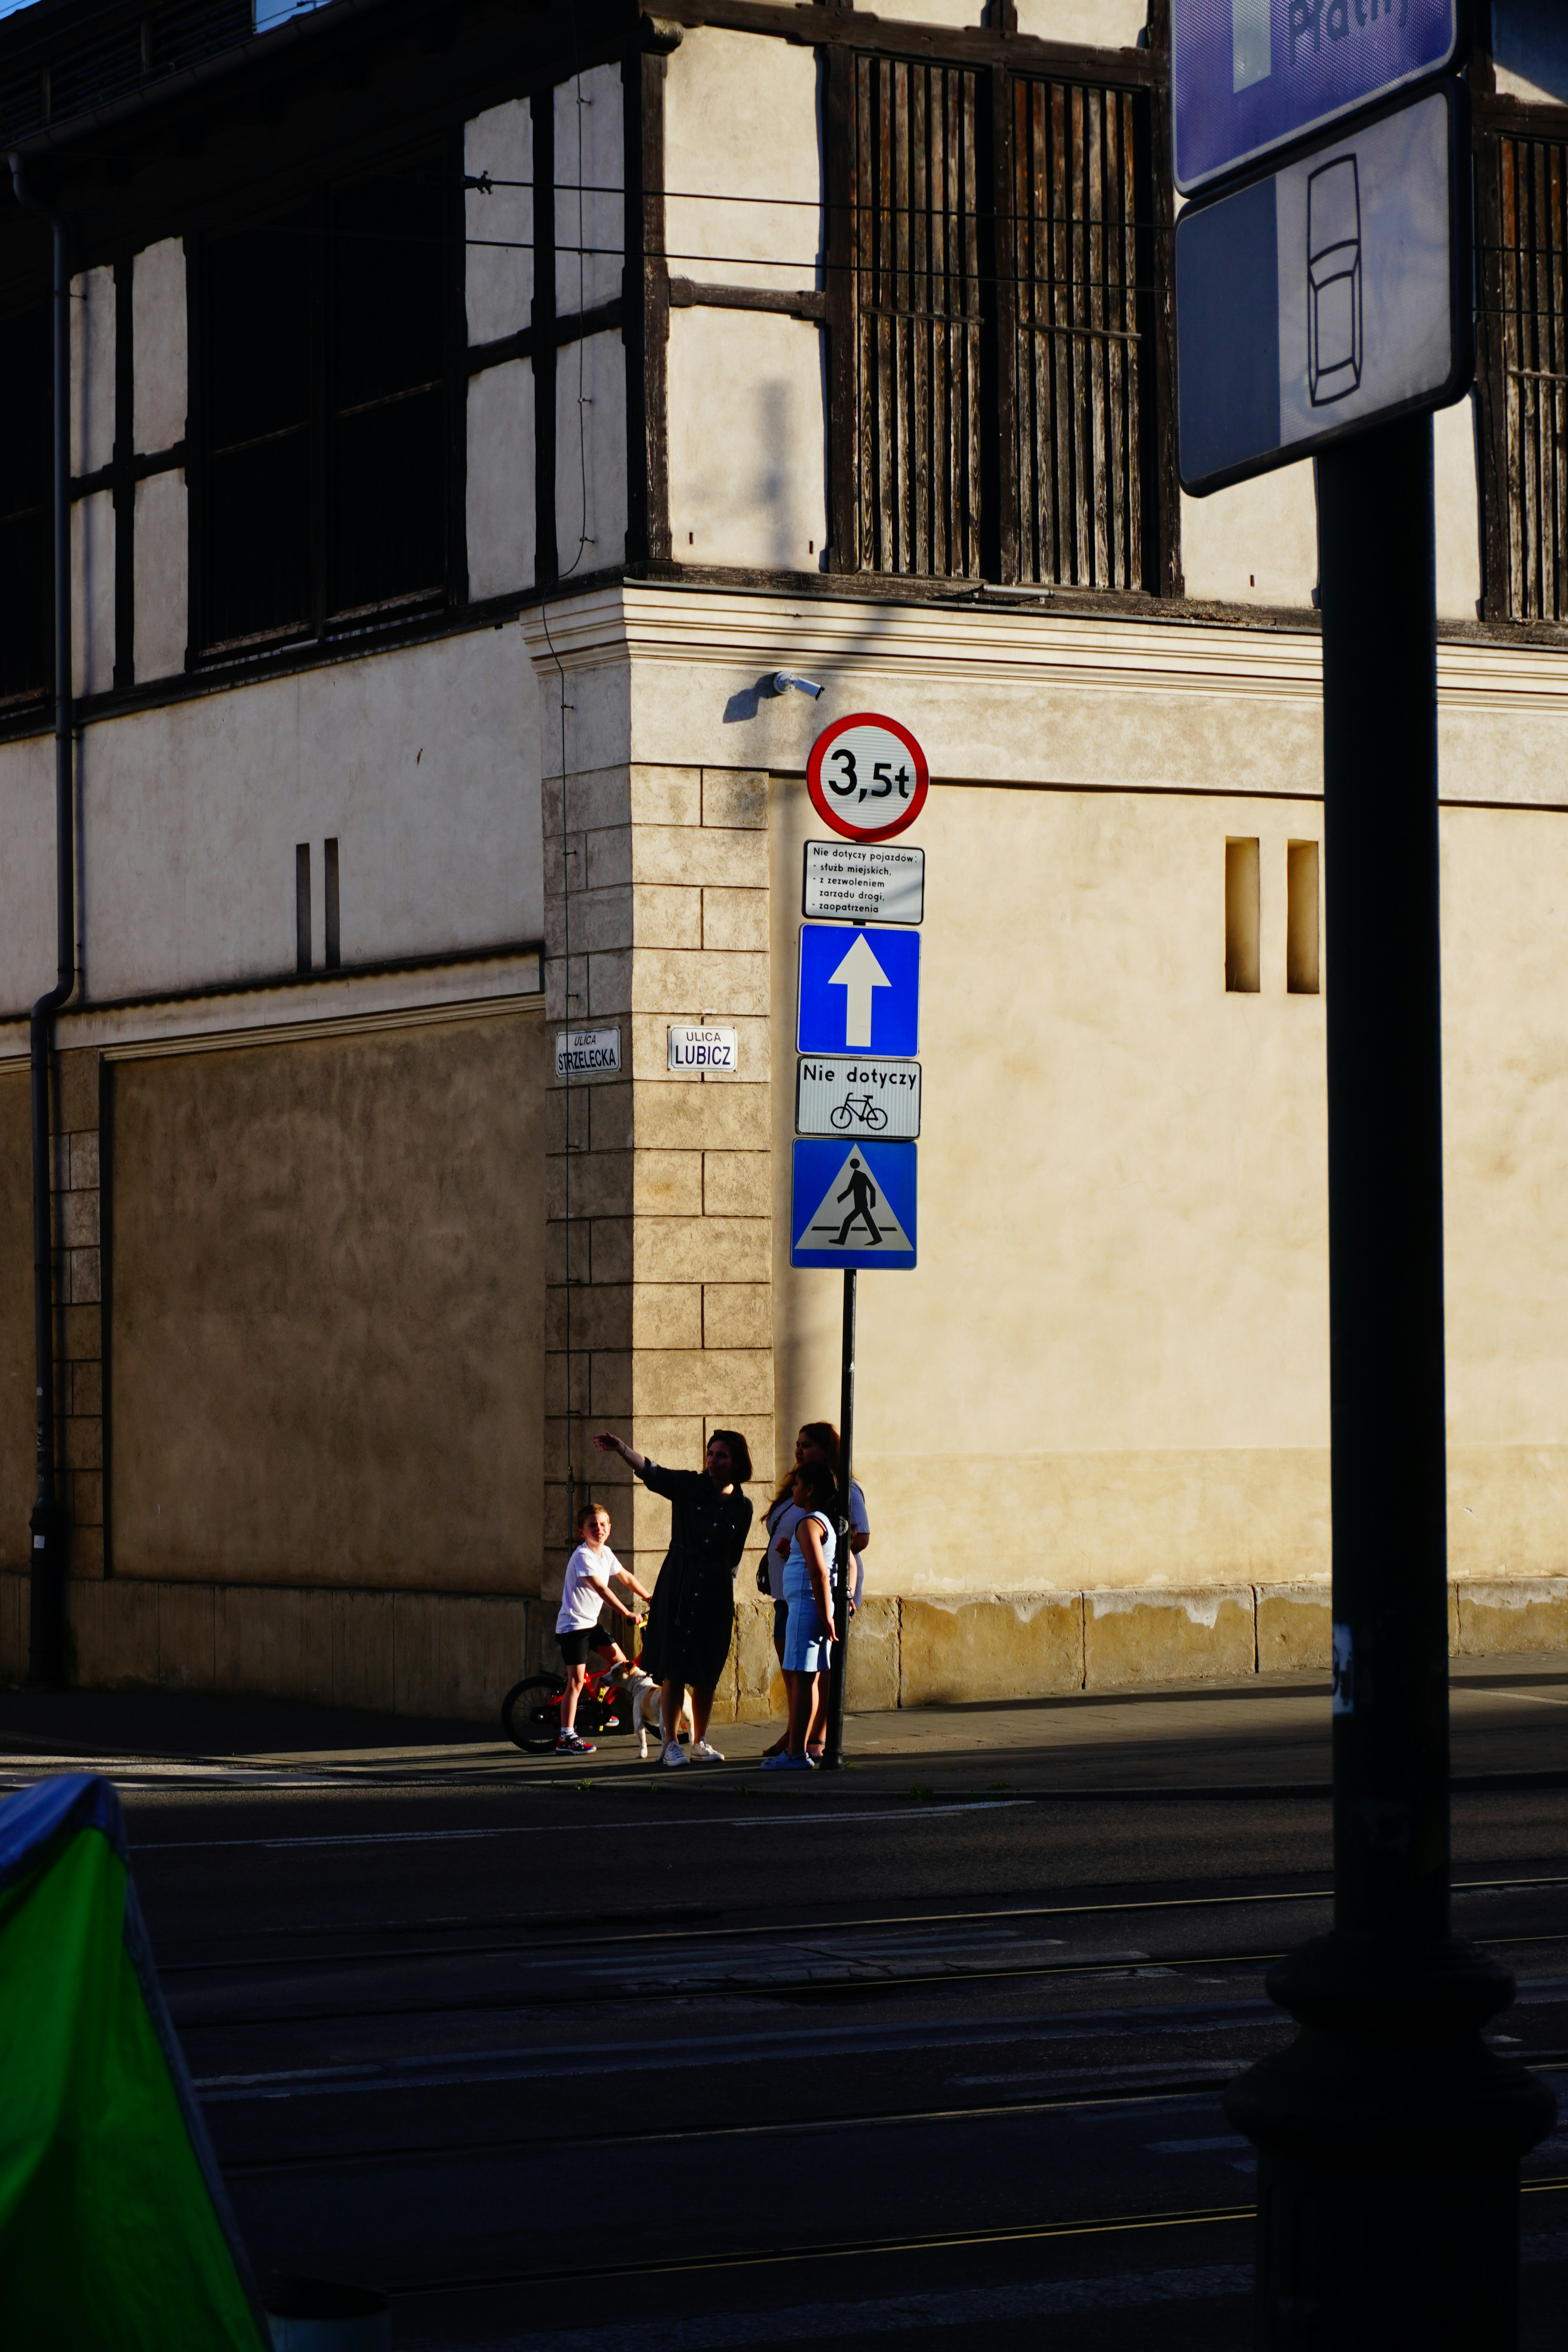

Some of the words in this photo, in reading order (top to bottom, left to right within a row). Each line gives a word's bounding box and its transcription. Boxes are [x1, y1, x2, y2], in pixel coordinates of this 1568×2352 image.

[828, 749, 909, 803] 3,5t
[813, 848, 829, 856] Nie
[833, 849, 866, 861] dotyczy
[870, 853, 917, 863] pojazdów:
[820, 863, 843, 872] służb
[848, 865, 891, 876] miejskich,
[828, 877, 884, 887] zezwoleniem
[820, 890, 855, 900] zarządu
[858, 891, 884, 902] drogi,
[819, 903, 878, 913] zaopatrzenia
[574, 1033, 596, 1046] ULICA
[686, 1032, 721, 1042] ULICA
[558, 1048, 616, 1071] STRZELECKA
[675, 1045, 731, 1065] LUBICZ
[804, 1064, 835, 1081] Nie
[847, 1067, 916, 1090] dotyczy
